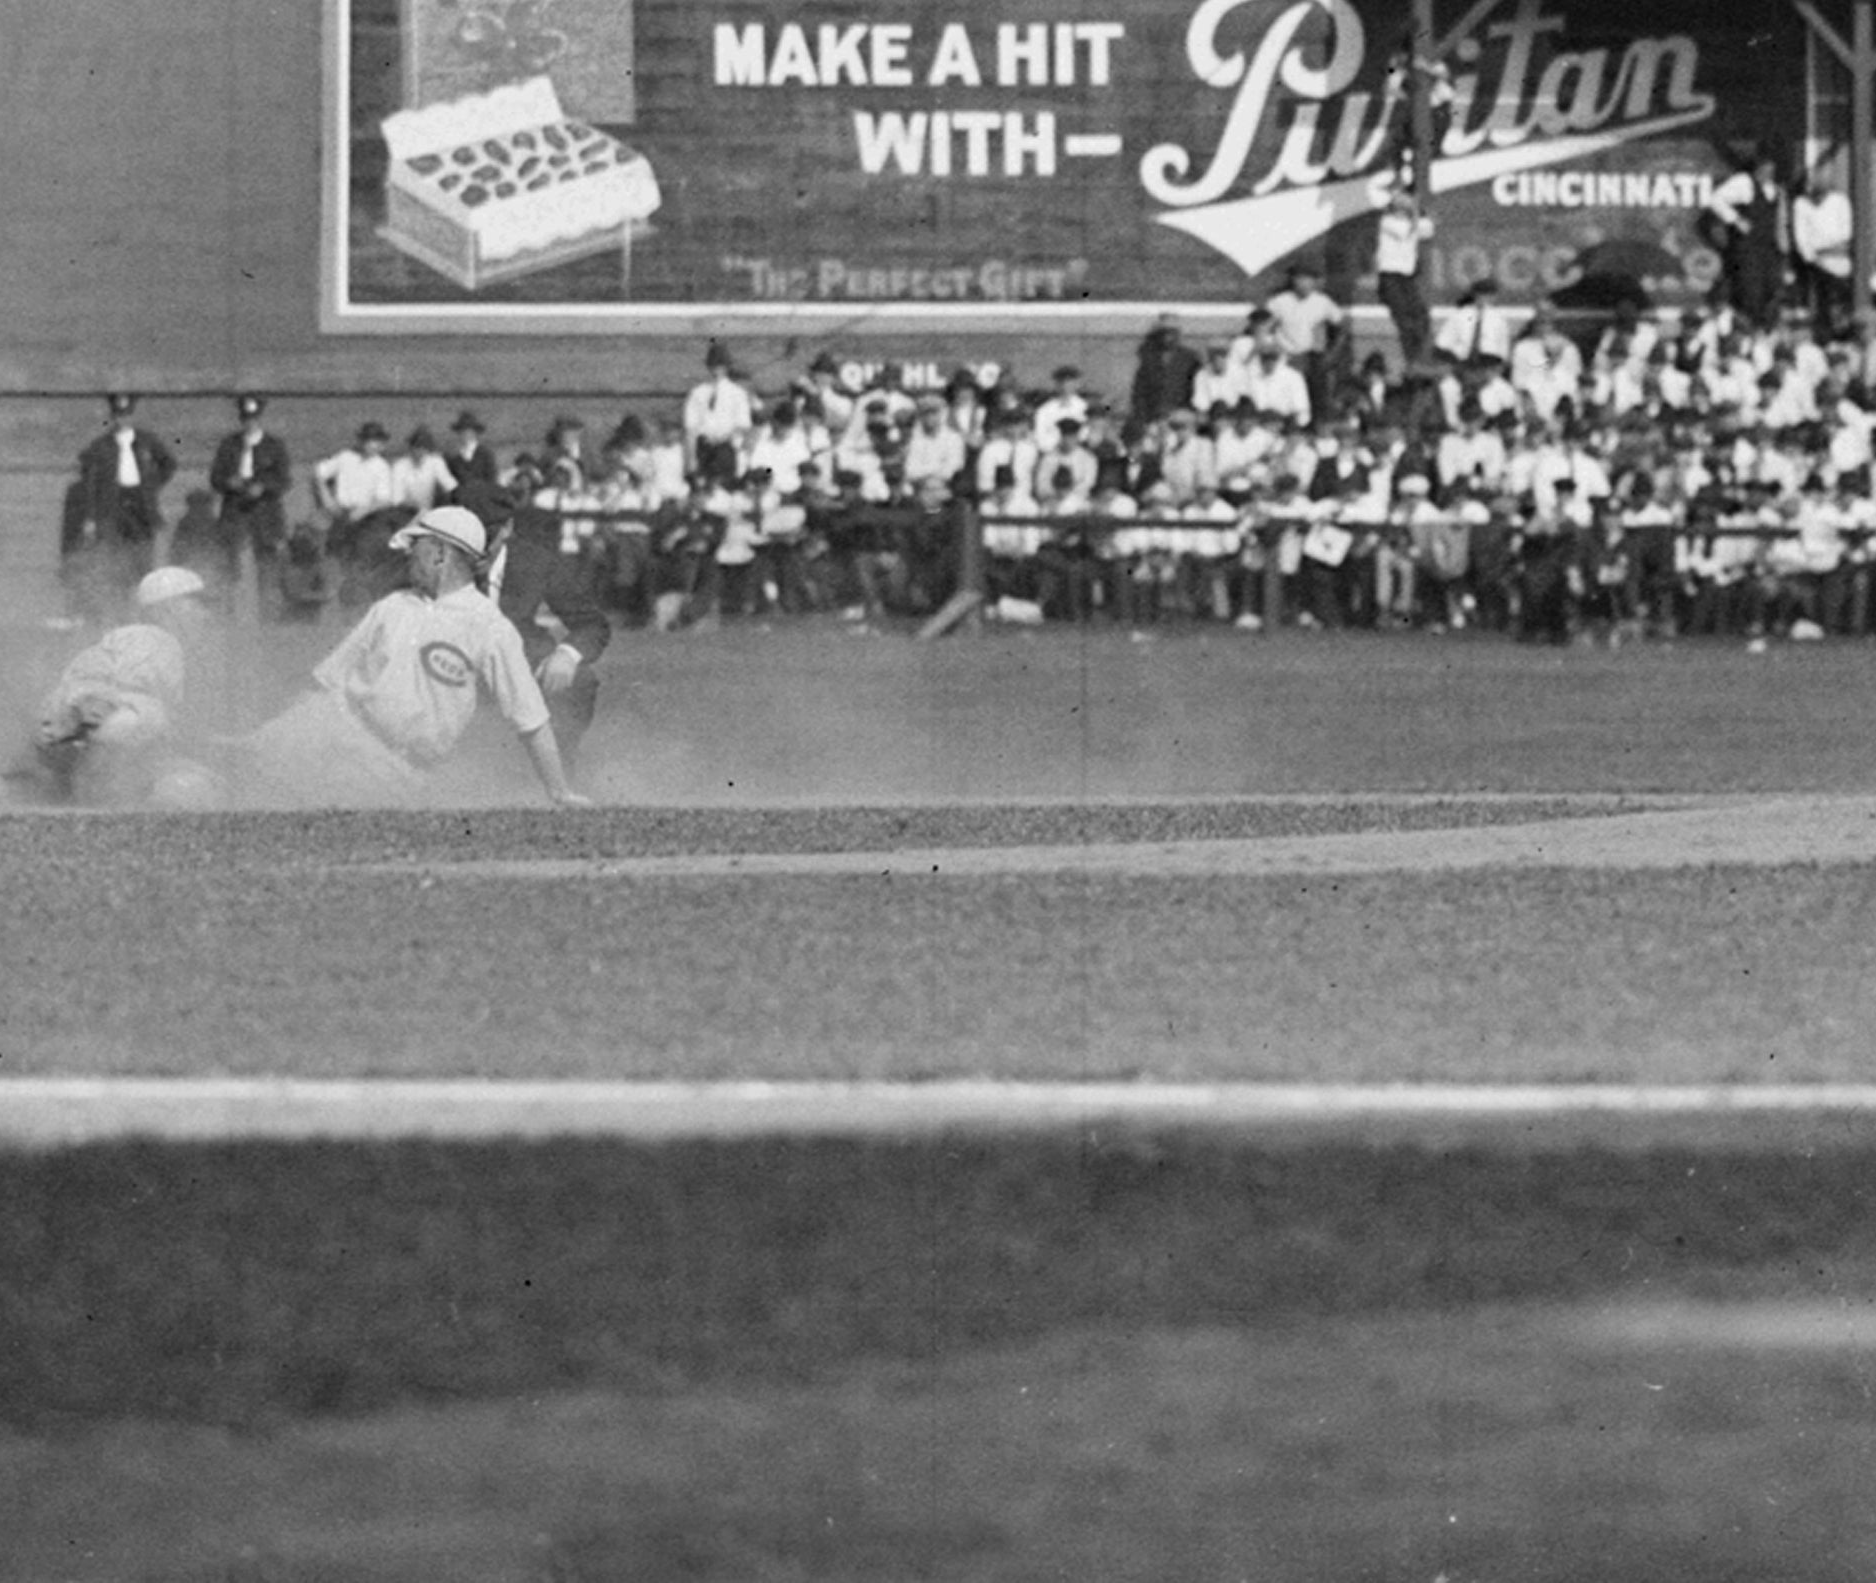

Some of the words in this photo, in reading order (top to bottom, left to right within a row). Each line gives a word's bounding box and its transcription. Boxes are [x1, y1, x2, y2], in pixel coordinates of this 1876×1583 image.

[713, 23, 915, 88] MAKE
[928, 23, 983, 88] A
[997, 22, 1127, 88] HIT
[1491, 170, 1717, 208] CINCINNATI
